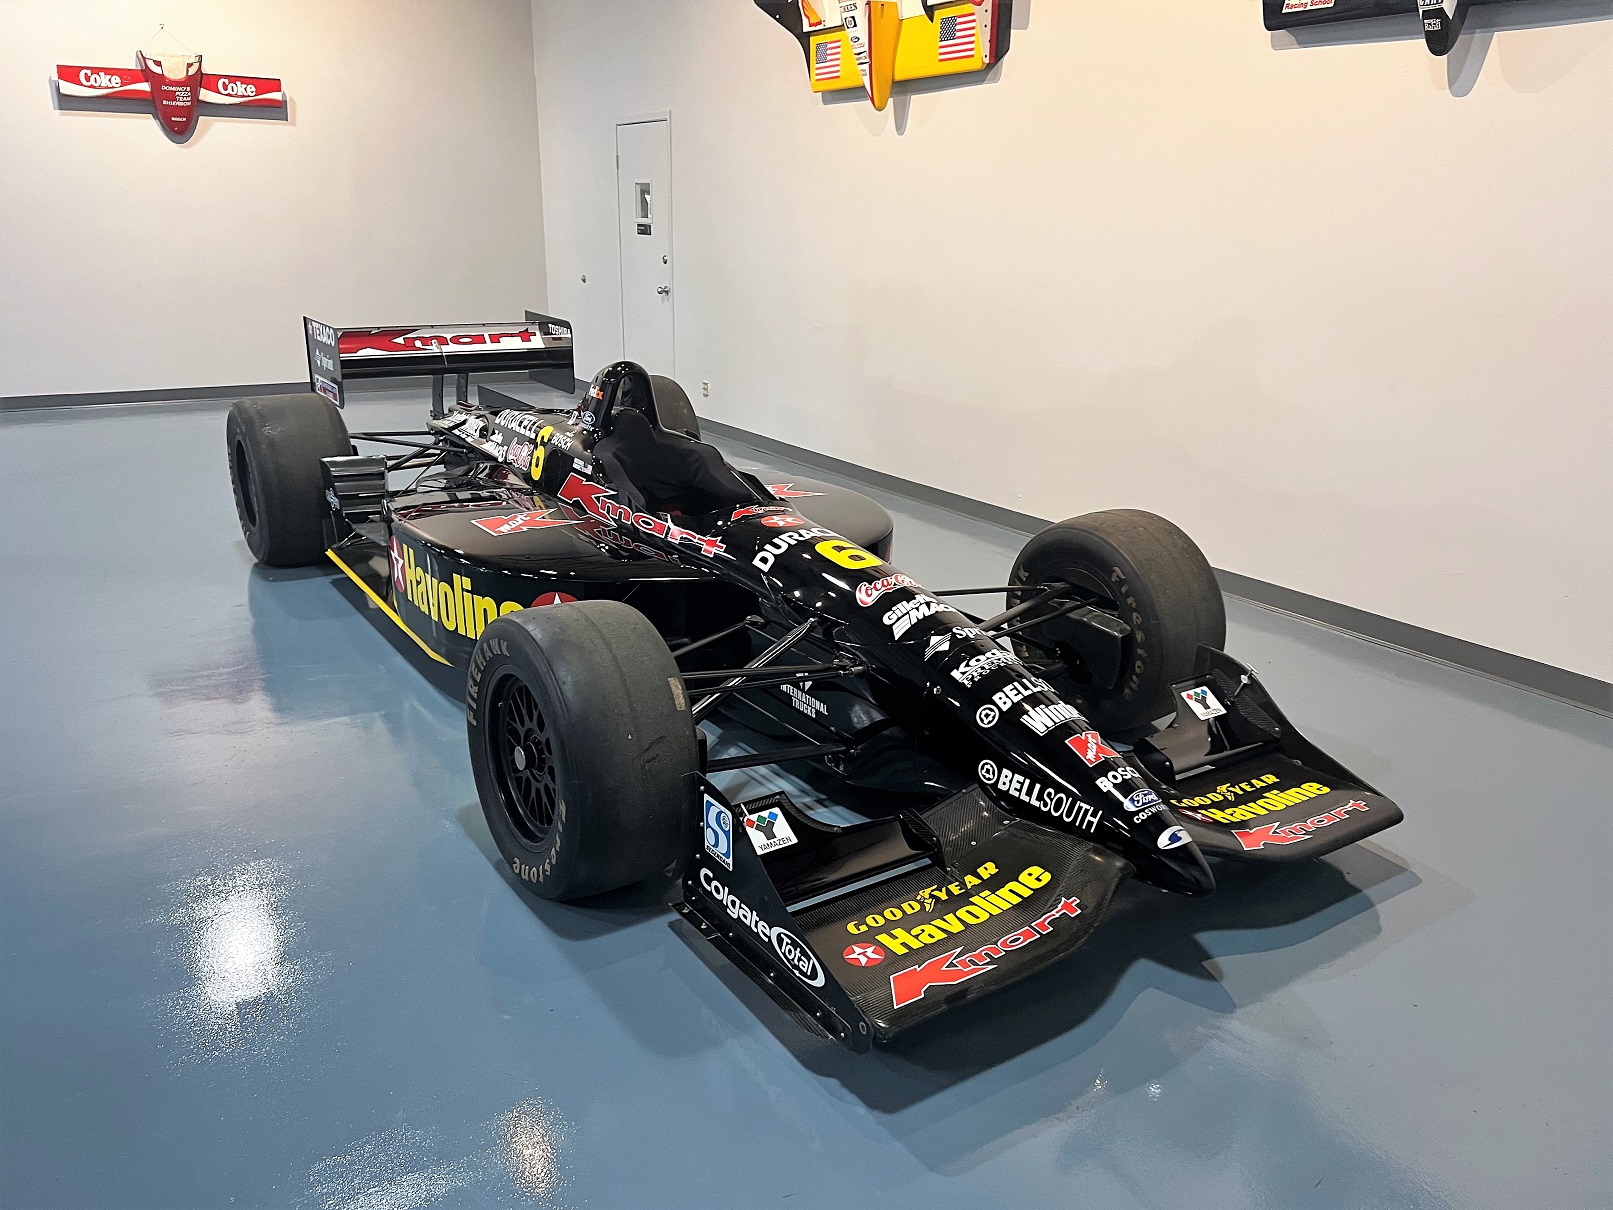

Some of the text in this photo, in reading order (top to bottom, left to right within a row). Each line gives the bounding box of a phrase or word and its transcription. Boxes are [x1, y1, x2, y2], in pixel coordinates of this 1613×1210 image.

[79, 69, 122, 89] Coke
[217, 78, 256, 97] Coke
[339, 327, 537, 355] Kmart
[531, 425, 554, 481] 6
[557, 472, 726, 559] Kmart
[752, 527, 846, 573] DURAC
[815, 540, 883, 569] 6
[467, 638, 510, 726] FIREHAWK
[780, 684, 828, 715] INTERNATIONAL
[792, 697, 816, 719] TRUCKS
[998, 768, 1102, 833] BELLSOUTH
[1095, 766, 1142, 792] BOSC
[1198, 782, 1331, 823] Havoline
[757, 836, 792, 851] YAMAZEN
[1232, 799, 1370, 850] Kmart
[700, 867, 772, 943] Colgate
[875, 865, 1052, 956] Havoline
[779, 933, 814, 976] Total
[890, 897, 1082, 1009] Kmart
